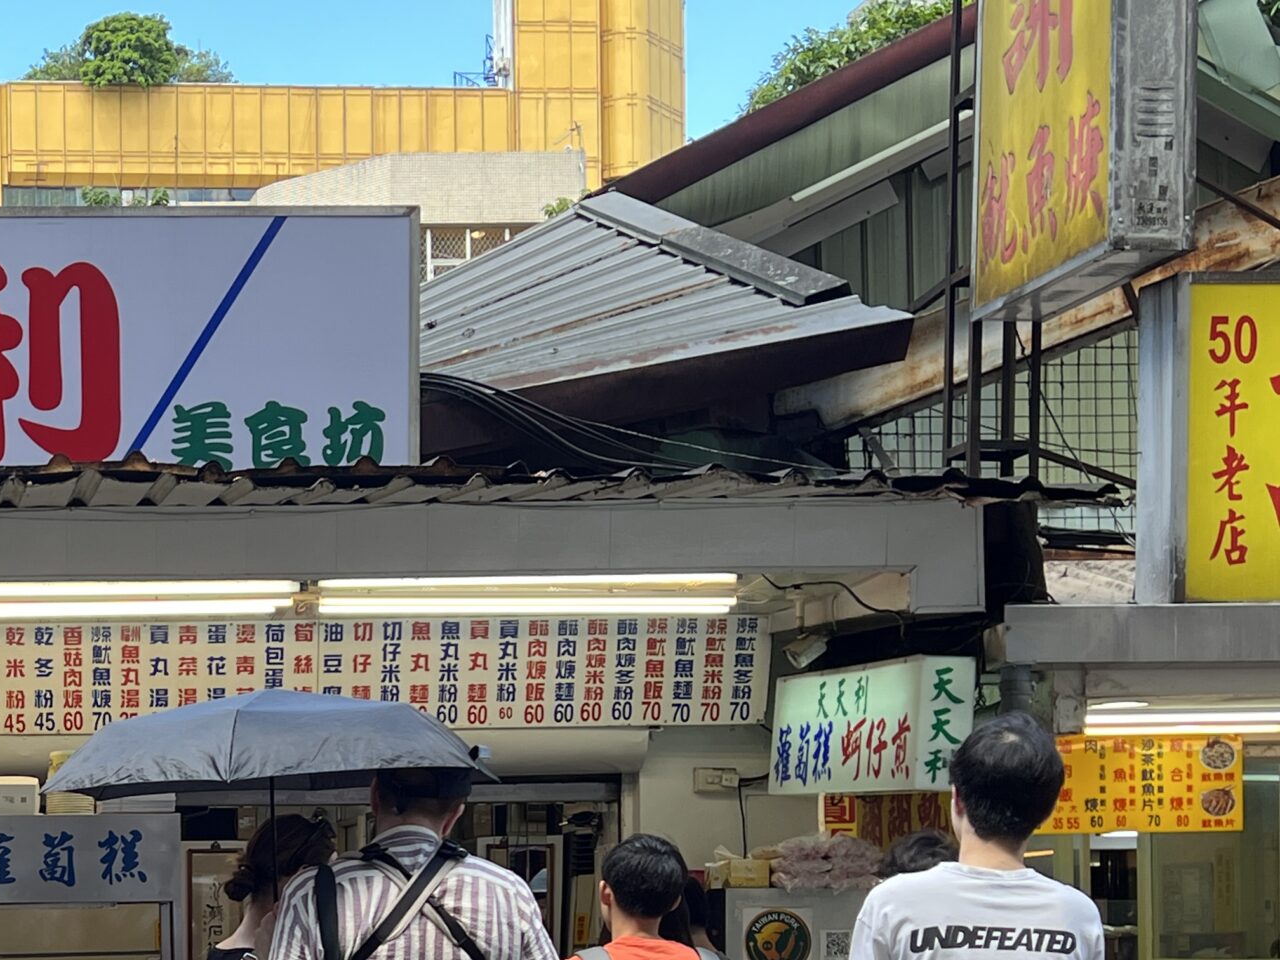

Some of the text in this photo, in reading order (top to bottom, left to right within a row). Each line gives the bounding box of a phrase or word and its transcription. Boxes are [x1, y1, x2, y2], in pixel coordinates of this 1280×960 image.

[171, 400, 386, 472] 美食坊
[1207, 315, 1258, 566] 50年老店
[149, 625, 169, 708] 貢丸湯
[265, 624, 285, 689] 荷包蛋
[380, 621, 403, 702] 切仔米粉
[409, 621, 431, 703] 魚丸麵
[496, 620, 519, 720] 貢丸米粉 60
[4, 627, 26, 733] 乾米粉 45
[34, 627, 55, 731] 乾冬粉 45
[436, 621, 461, 724] 魚丸米粉 60
[467, 620, 489, 724] 貢丸麵 60
[580, 702, 602, 722] 60
[612, 701, 632, 720] 60
[641, 701, 661, 721] 70
[700, 702, 720, 722] 70
[730, 701, 750, 721] 70
[817, 675, 869, 719] 天天利
[63, 712, 83, 731] 60
[92, 712, 112, 731] 70
[524, 704, 544, 723] 60
[554, 703, 574, 723] 60
[672, 703, 690, 723] 70
[841, 711, 912, 781] 蚵仔煎
[1090, 816, 1103, 828] 60
[1148, 815, 1160, 827] 70
[752, 913, 778, 932] TAIWAN
[910, 925, 1077, 955] UNDEFEATED
